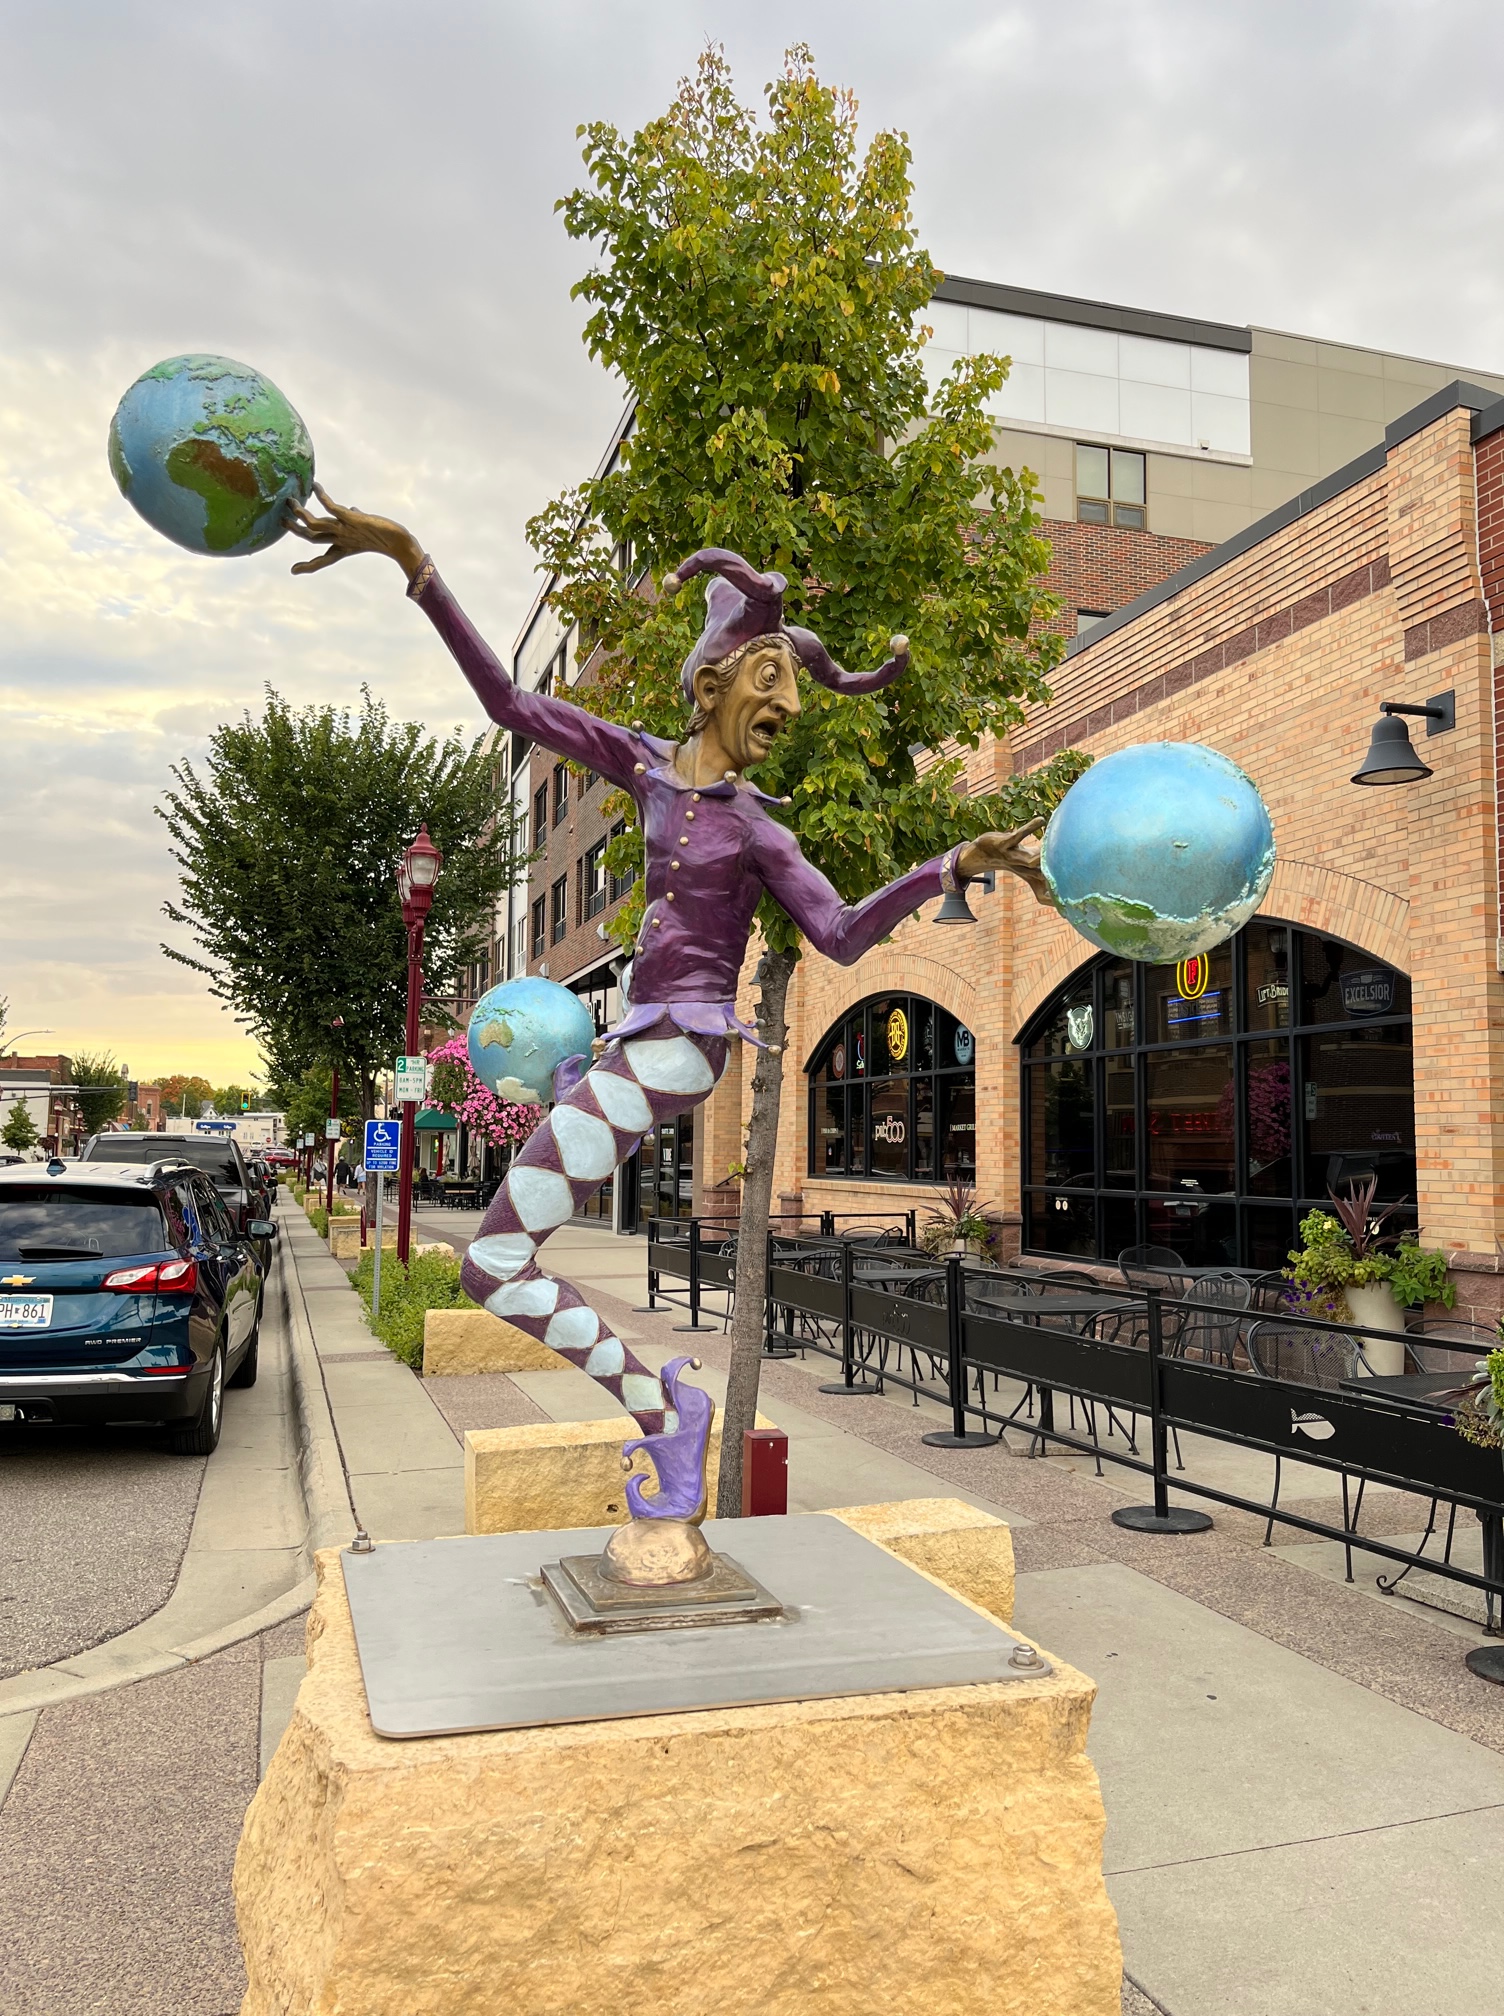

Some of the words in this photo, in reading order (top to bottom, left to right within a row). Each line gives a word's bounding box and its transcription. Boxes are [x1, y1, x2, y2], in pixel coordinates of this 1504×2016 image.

[1258, 987, 1270, 1003] LIFT
[1345, 983, 1390, 1005] EXCELSIOR
[956, 1030, 970, 1048] MB
[397, 1059, 405, 1071] 2
[875, 1121, 888, 1141] pub
[887, 1115, 905, 1143] 500
[22, 1303, 46, 1319] 861
[105, 1337, 142, 1345] PREMIER
